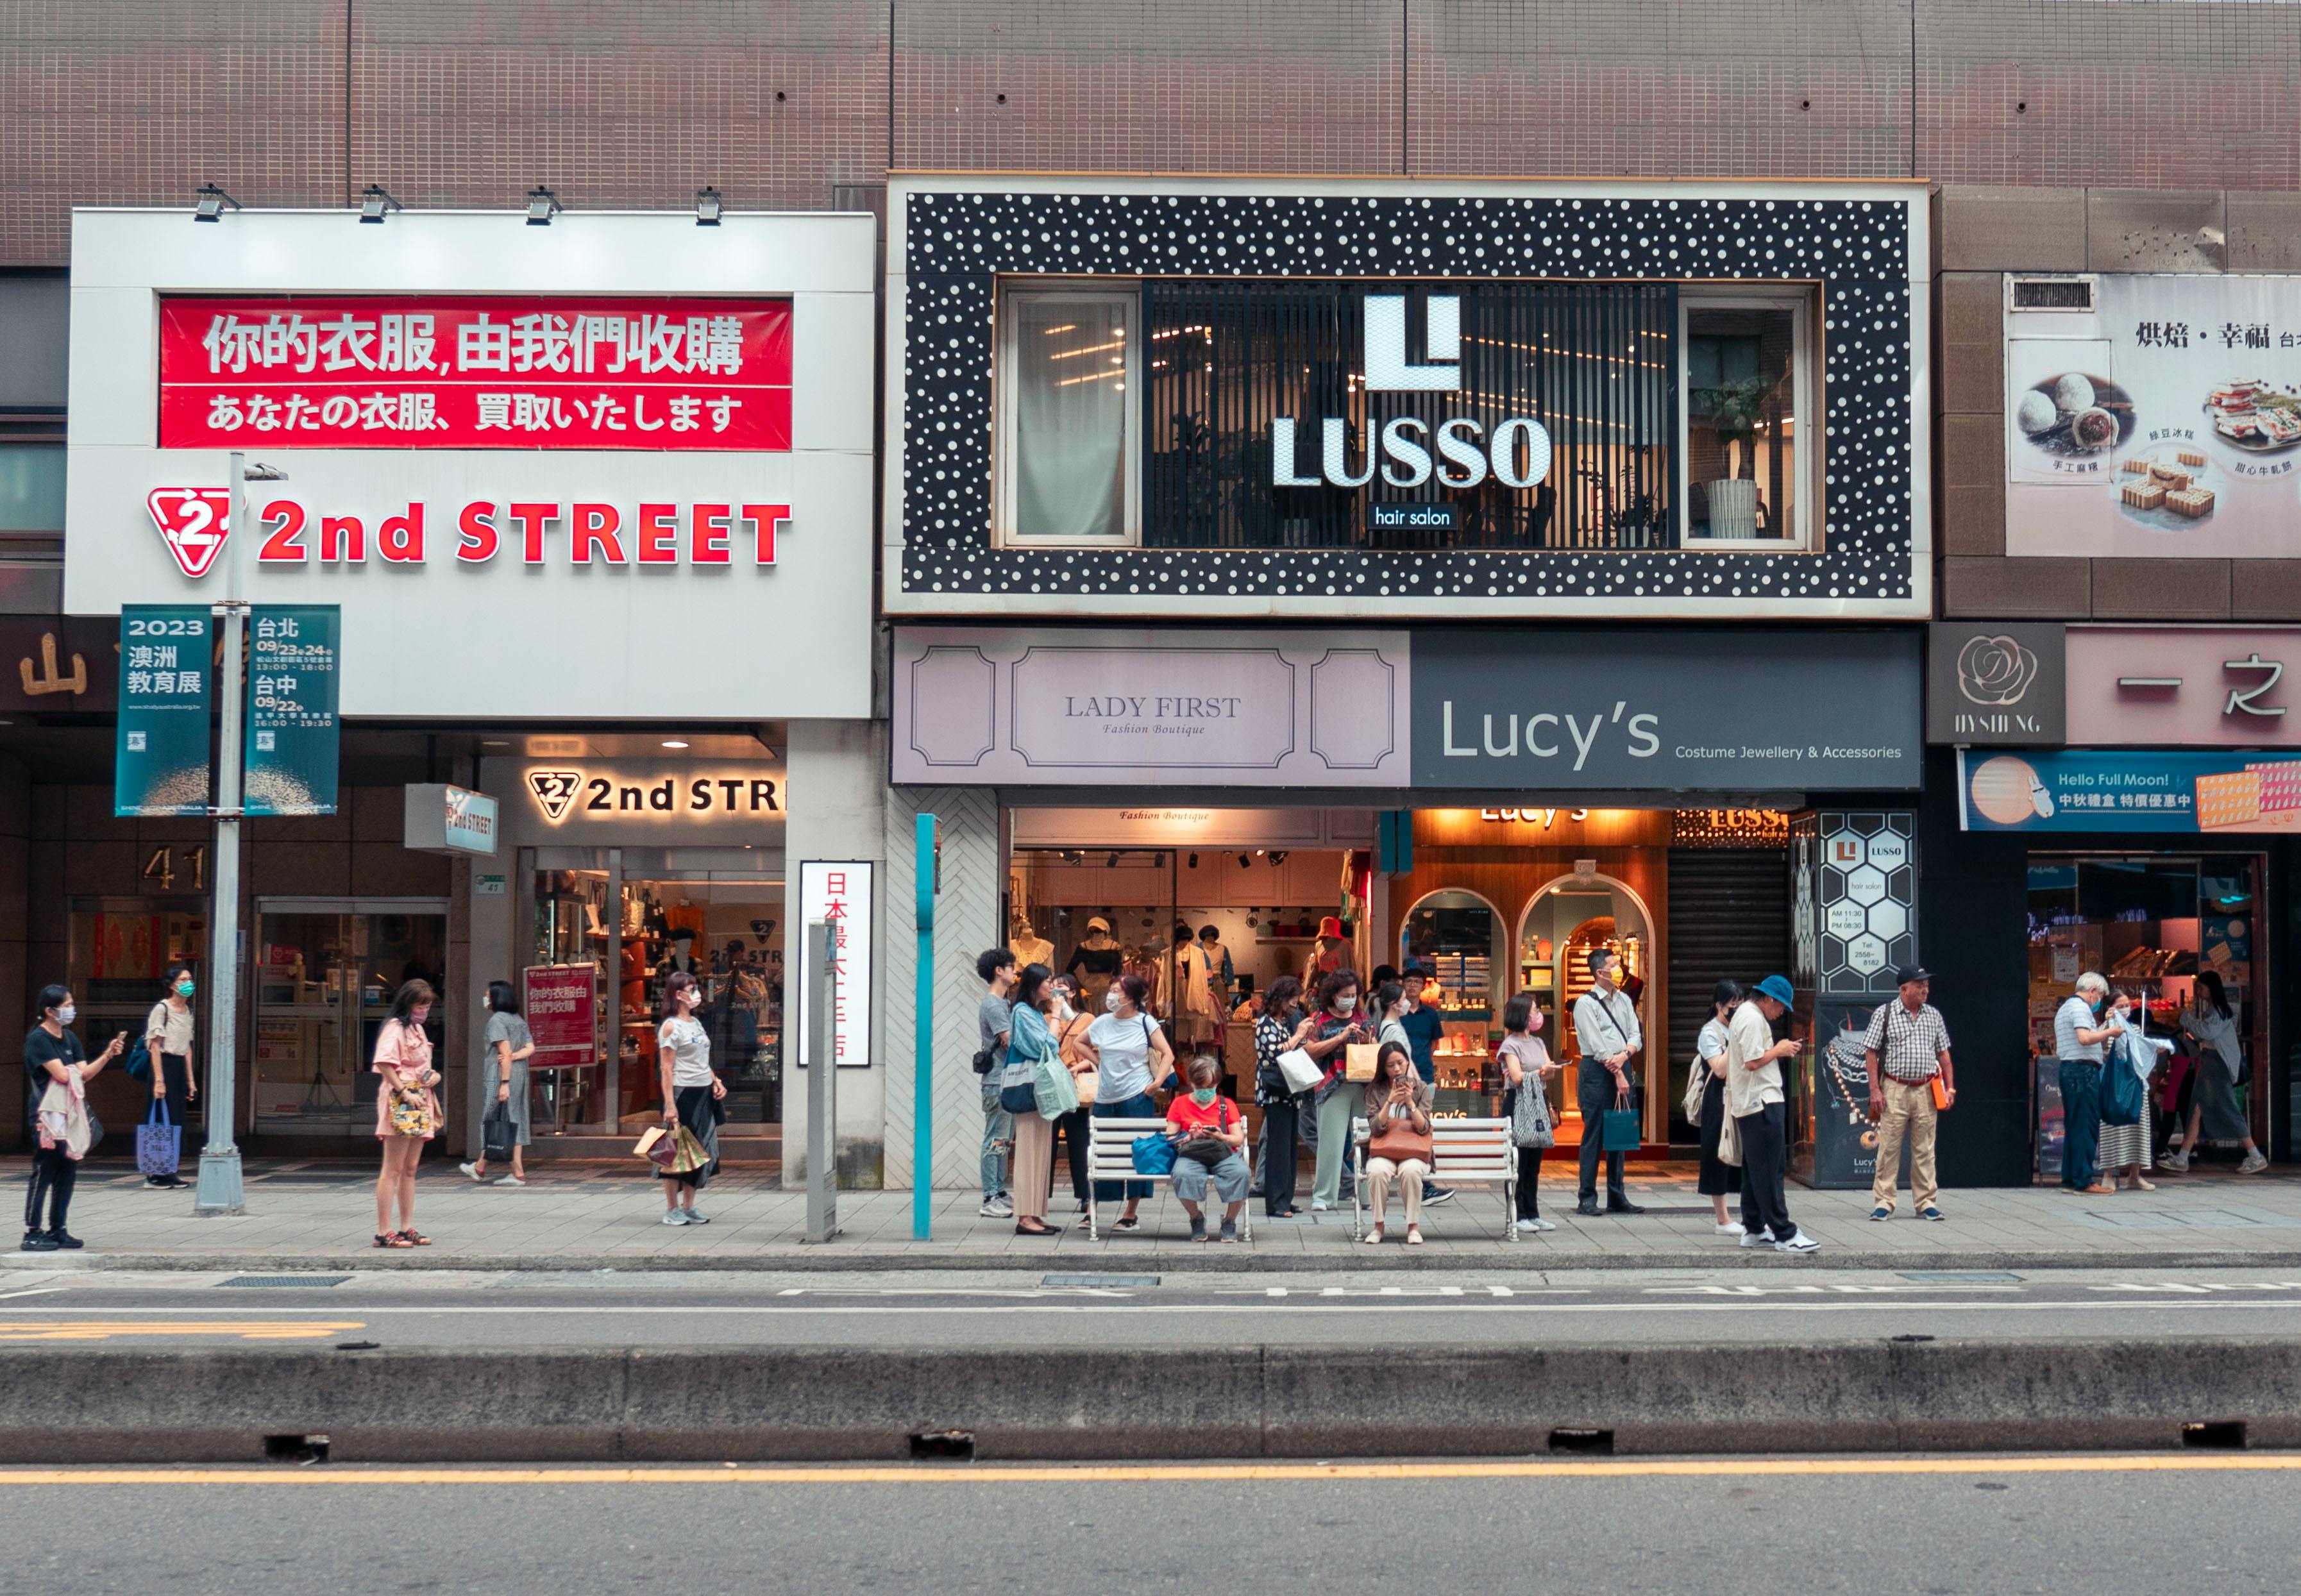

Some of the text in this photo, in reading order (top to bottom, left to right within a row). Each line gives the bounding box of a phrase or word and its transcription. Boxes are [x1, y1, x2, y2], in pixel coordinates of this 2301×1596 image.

[203, 312, 744, 376] 你的衣服,由我們收購
[207, 392, 742, 433] あなたの衣服、 買取いたします
[1273, 417, 1551, 489] LUSSO
[1376, 508, 1450, 525] hair salon
[257, 499, 793, 564] 2nd STREET
[129, 620, 204, 636] 2023
[257, 617, 298, 637] 台北
[20, 632, 87, 695] 山
[128, 645, 177, 668] 澳洲
[128, 671, 202, 694] 教育展
[255, 675, 297, 695] 台中
[1065, 696, 1242, 718] LADY FIRST
[1102, 723, 1205, 737] Fashion Boutique
[1443, 701, 1660, 771] Lucy's
[1675, 746, 1902, 760] Costume Jewellery & Accessories
[2059, 773, 2168, 786] Hello Full Moon!
[587, 778, 787, 811] 2nd STR
[454, 810, 491, 836] 2nd STREET
[1120, 811, 1210, 822] Fashion Boutique
[1872, 848, 1901, 856] LUSSO
[1851, 881, 1882, 890] hair salon
[530, 986, 587, 1000] 你的衣服由
[530, 1000, 576, 1014] 我們收購
